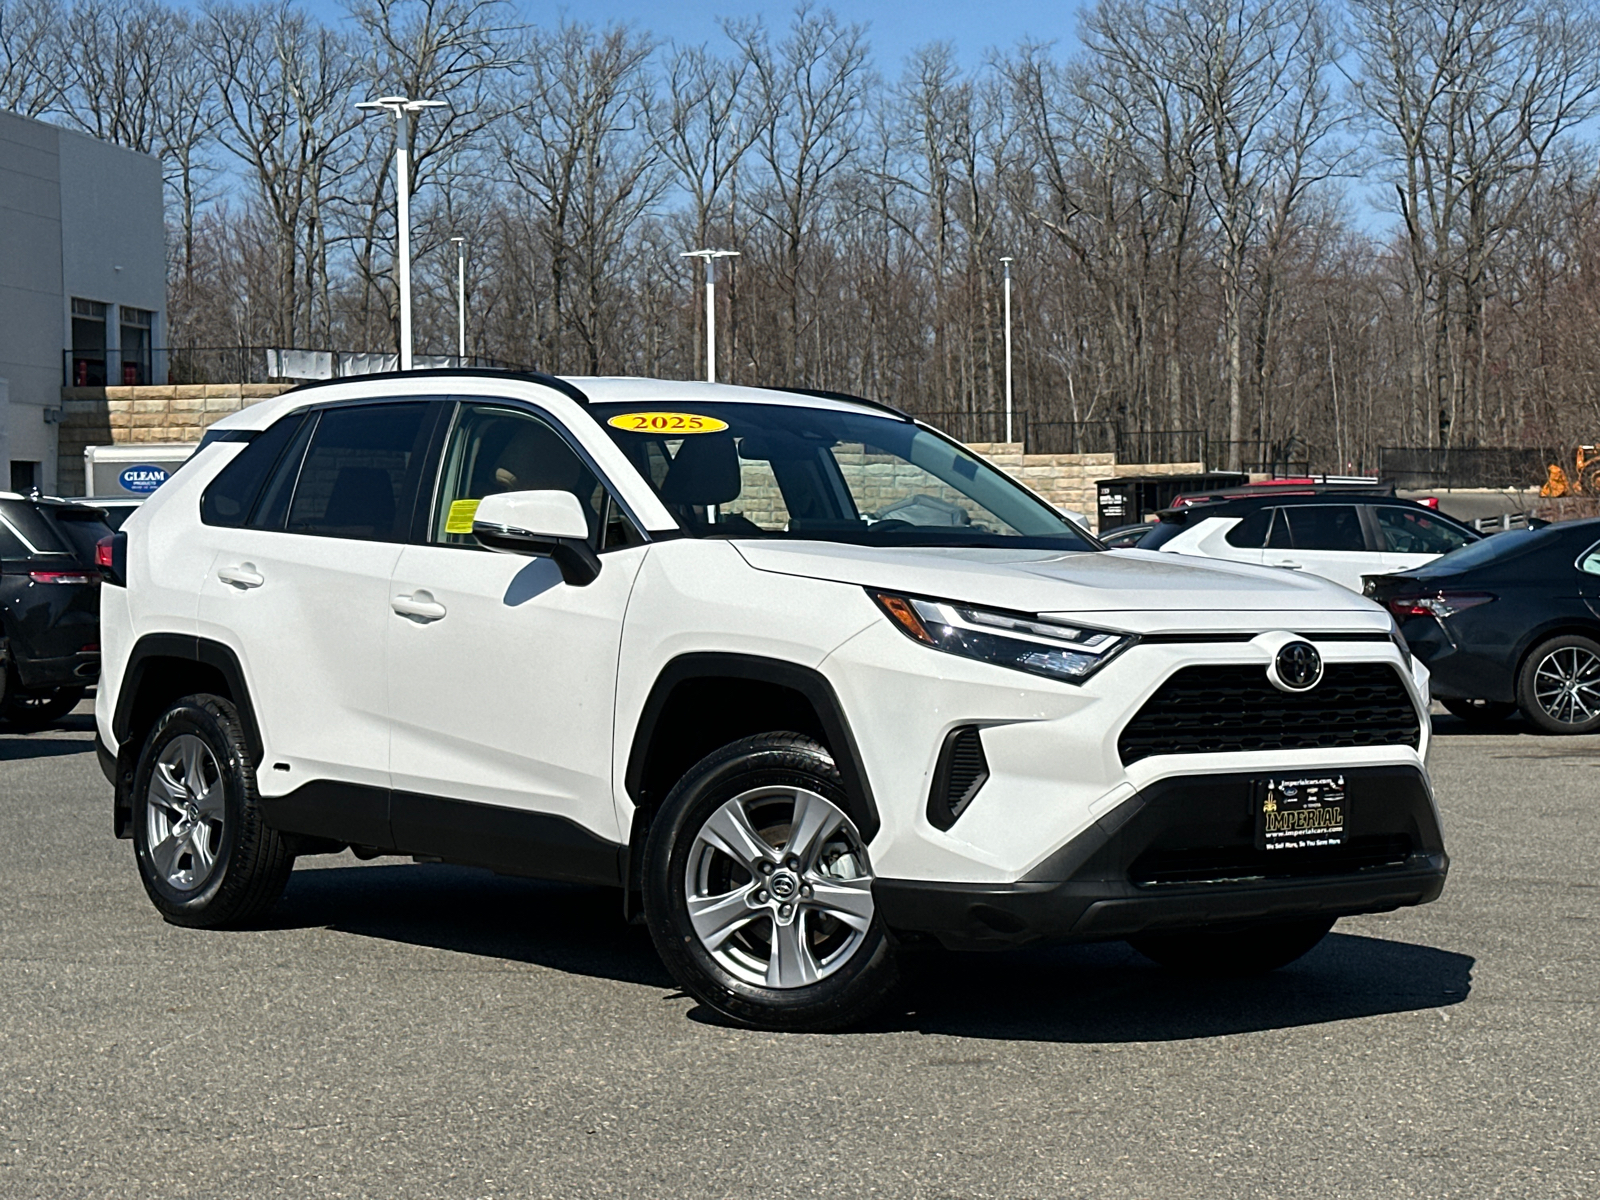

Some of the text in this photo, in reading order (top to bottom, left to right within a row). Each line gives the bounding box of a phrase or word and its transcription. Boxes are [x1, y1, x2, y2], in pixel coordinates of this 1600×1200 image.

[632, 416, 703, 429] 2025
[124, 471, 165, 481] GLEAM
[1265, 807, 1344, 831] IMPERIAL
[1265, 827, 1343, 838] www.imperialcars.com
